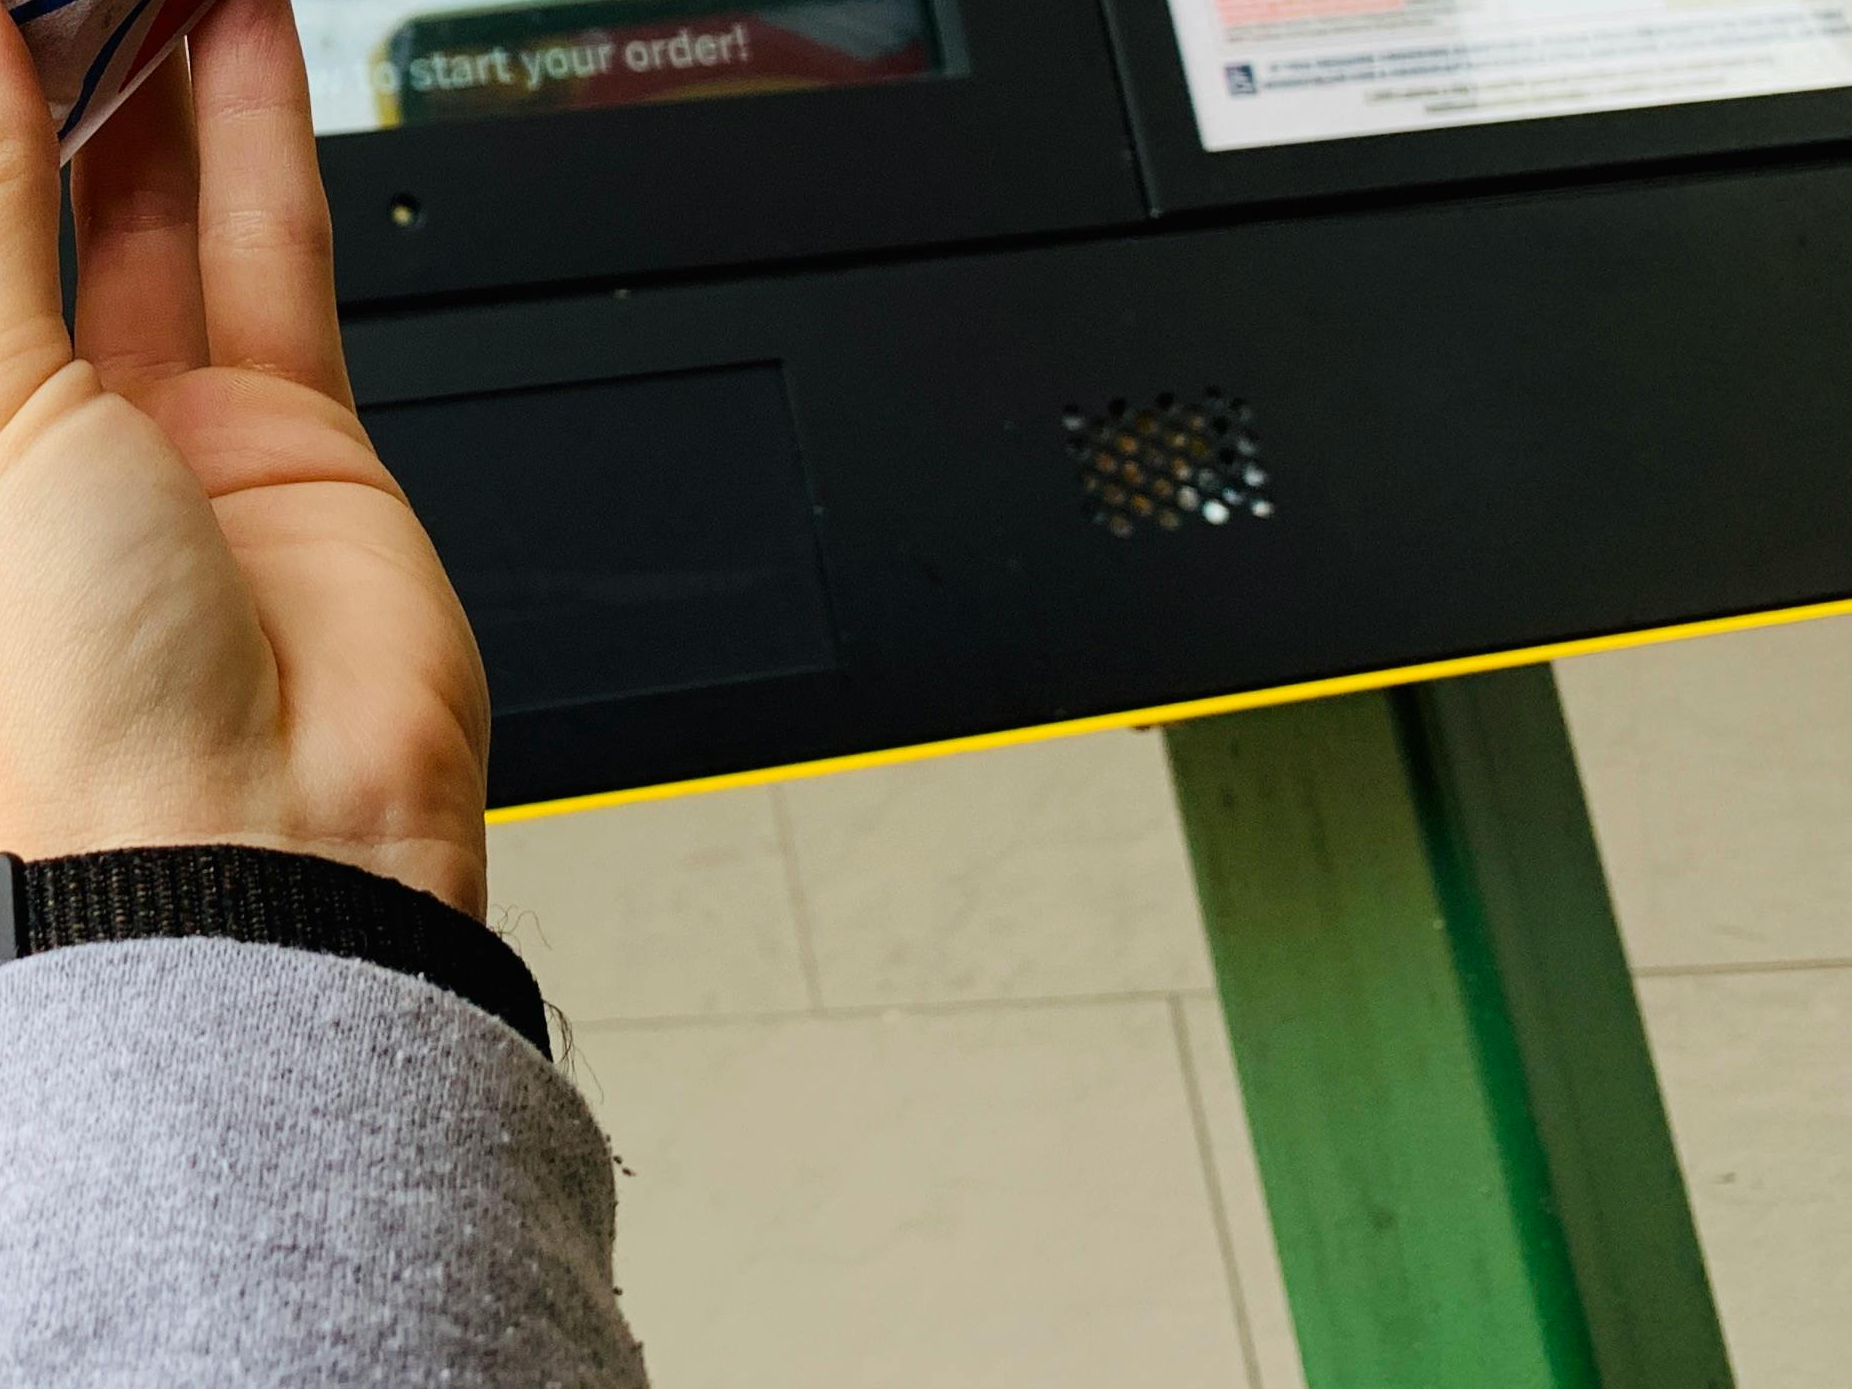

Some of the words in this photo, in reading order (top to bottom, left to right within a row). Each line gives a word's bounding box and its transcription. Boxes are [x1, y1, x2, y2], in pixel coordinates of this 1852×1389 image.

[410, 47, 513, 93] start
[525, 38, 613, 91] your
[625, 22, 749, 74] order!
